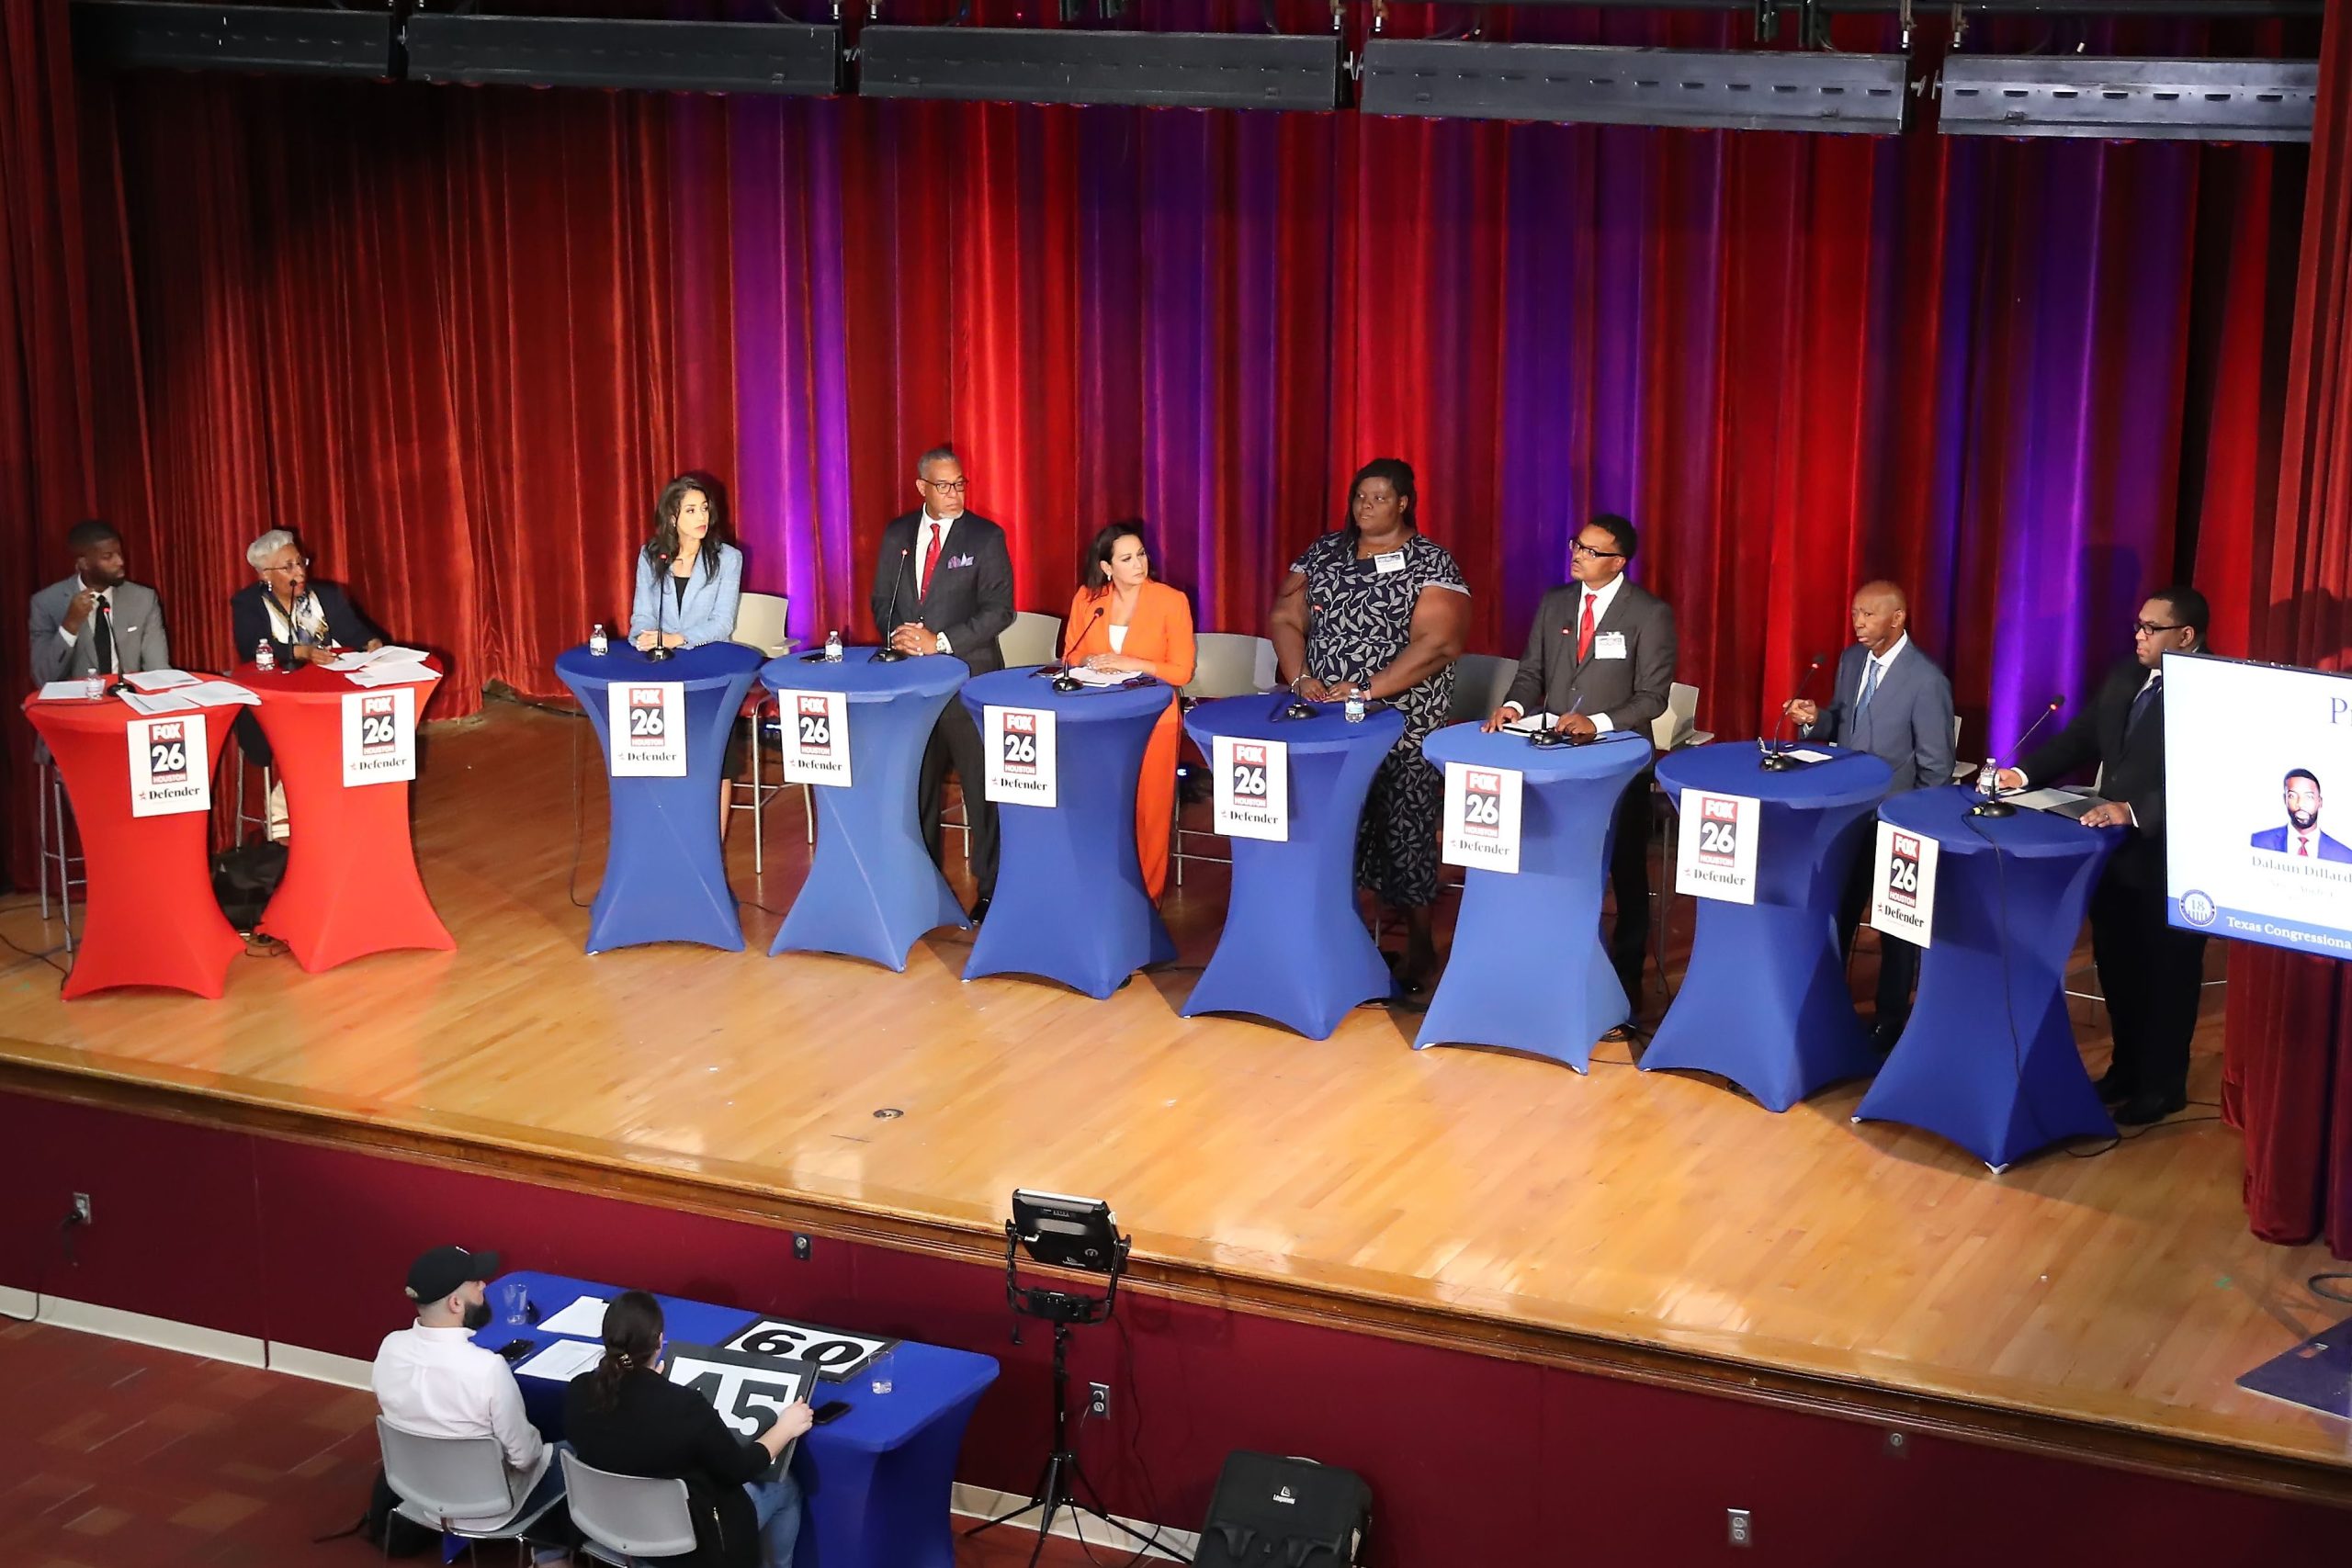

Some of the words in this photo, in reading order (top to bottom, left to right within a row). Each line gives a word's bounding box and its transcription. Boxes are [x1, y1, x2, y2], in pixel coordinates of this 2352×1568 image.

[365, 696, 392, 714] FOX
[632, 689, 661, 705] FOX
[800, 697, 826, 714] FOX
[363, 716, 394, 744] 26
[631, 708, 663, 736] 26
[800, 716, 830, 743] 26
[1006, 714, 1033, 731] FOX
[152, 723, 182, 740] FOX
[628, 752, 677, 761] Defender
[1005, 734, 1035, 762] 26
[1236, 745, 1264, 762] FOX
[152, 742, 185, 773] 26
[359, 758, 407, 770] Defender
[798, 759, 842, 771] Defender
[1001, 778, 1047, 790] Defender
[1235, 766, 1266, 795] 26
[1469, 773, 1498, 792] FOX
[149, 786, 200, 800] Defender
[1230, 810, 1278, 824] Defender
[1465, 794, 1498, 825] 26
[1704, 799, 1735, 819] FOX
[1701, 821, 1735, 853] 26
[1460, 840, 1510, 855] Defender
[1895, 834, 1917, 858] FOX
[1693, 869, 1746, 886] Defender
[1891, 858, 1917, 892] 26
[2252, 855, 2300, 874] Dalaun
[2305, 865, 2352, 883] Dillard
[1890, 891, 1916, 908] HOUSTON
[2192, 899, 2205, 911] 18
[1884, 905, 1925, 928] Defender
[2226, 916, 2262, 933] Texas
[741, 1329, 864, 1366] 60
